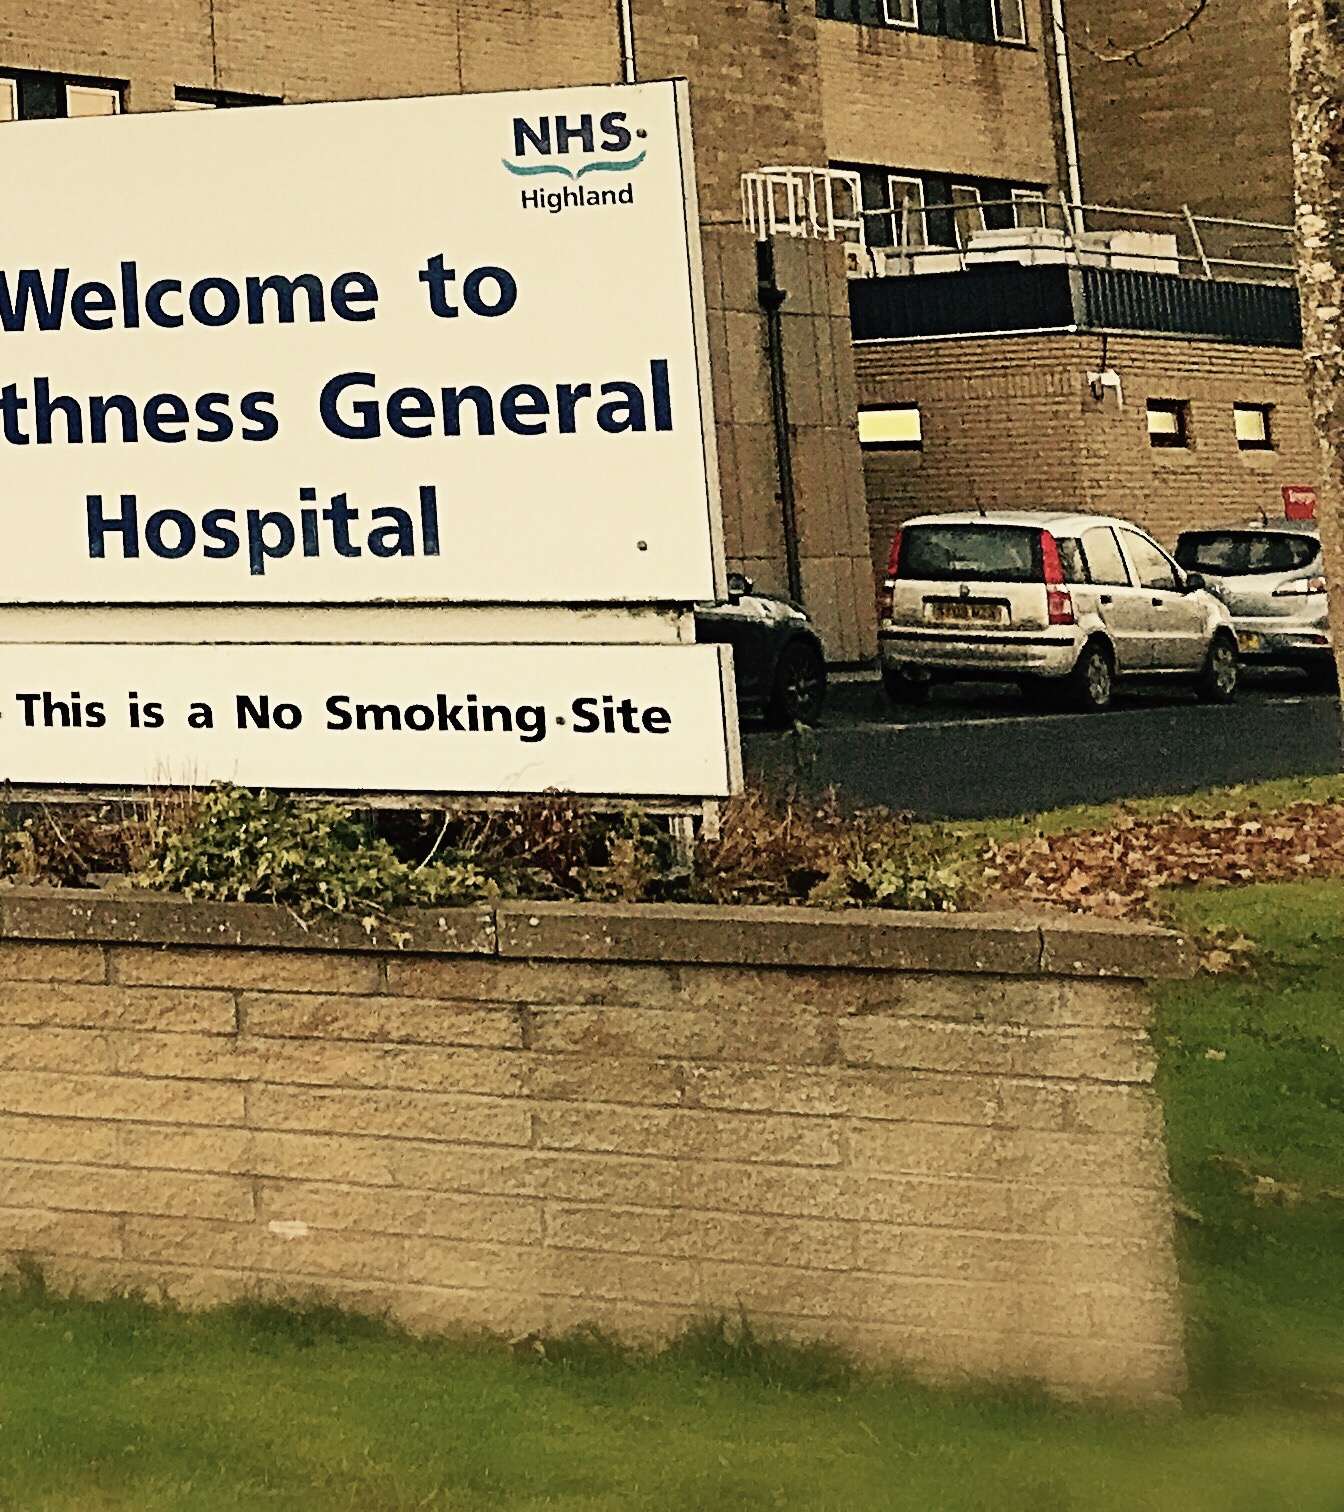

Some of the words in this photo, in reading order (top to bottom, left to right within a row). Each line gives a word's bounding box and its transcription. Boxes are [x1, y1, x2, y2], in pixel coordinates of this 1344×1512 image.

[512, 111, 632, 157] NHS
[521, 182, 634, 214] Highland
[418, 252, 518, 319] to
[319, 358, 673, 440] General
[86, 485, 441, 576] Hospital
[15, 693, 107, 729] This
[129, 693, 165, 729] is
[187, 702, 214, 729] a
[235, 694, 303, 730] No
[325, 693, 547, 743] Smoking
[571, 697, 672, 734] Site
